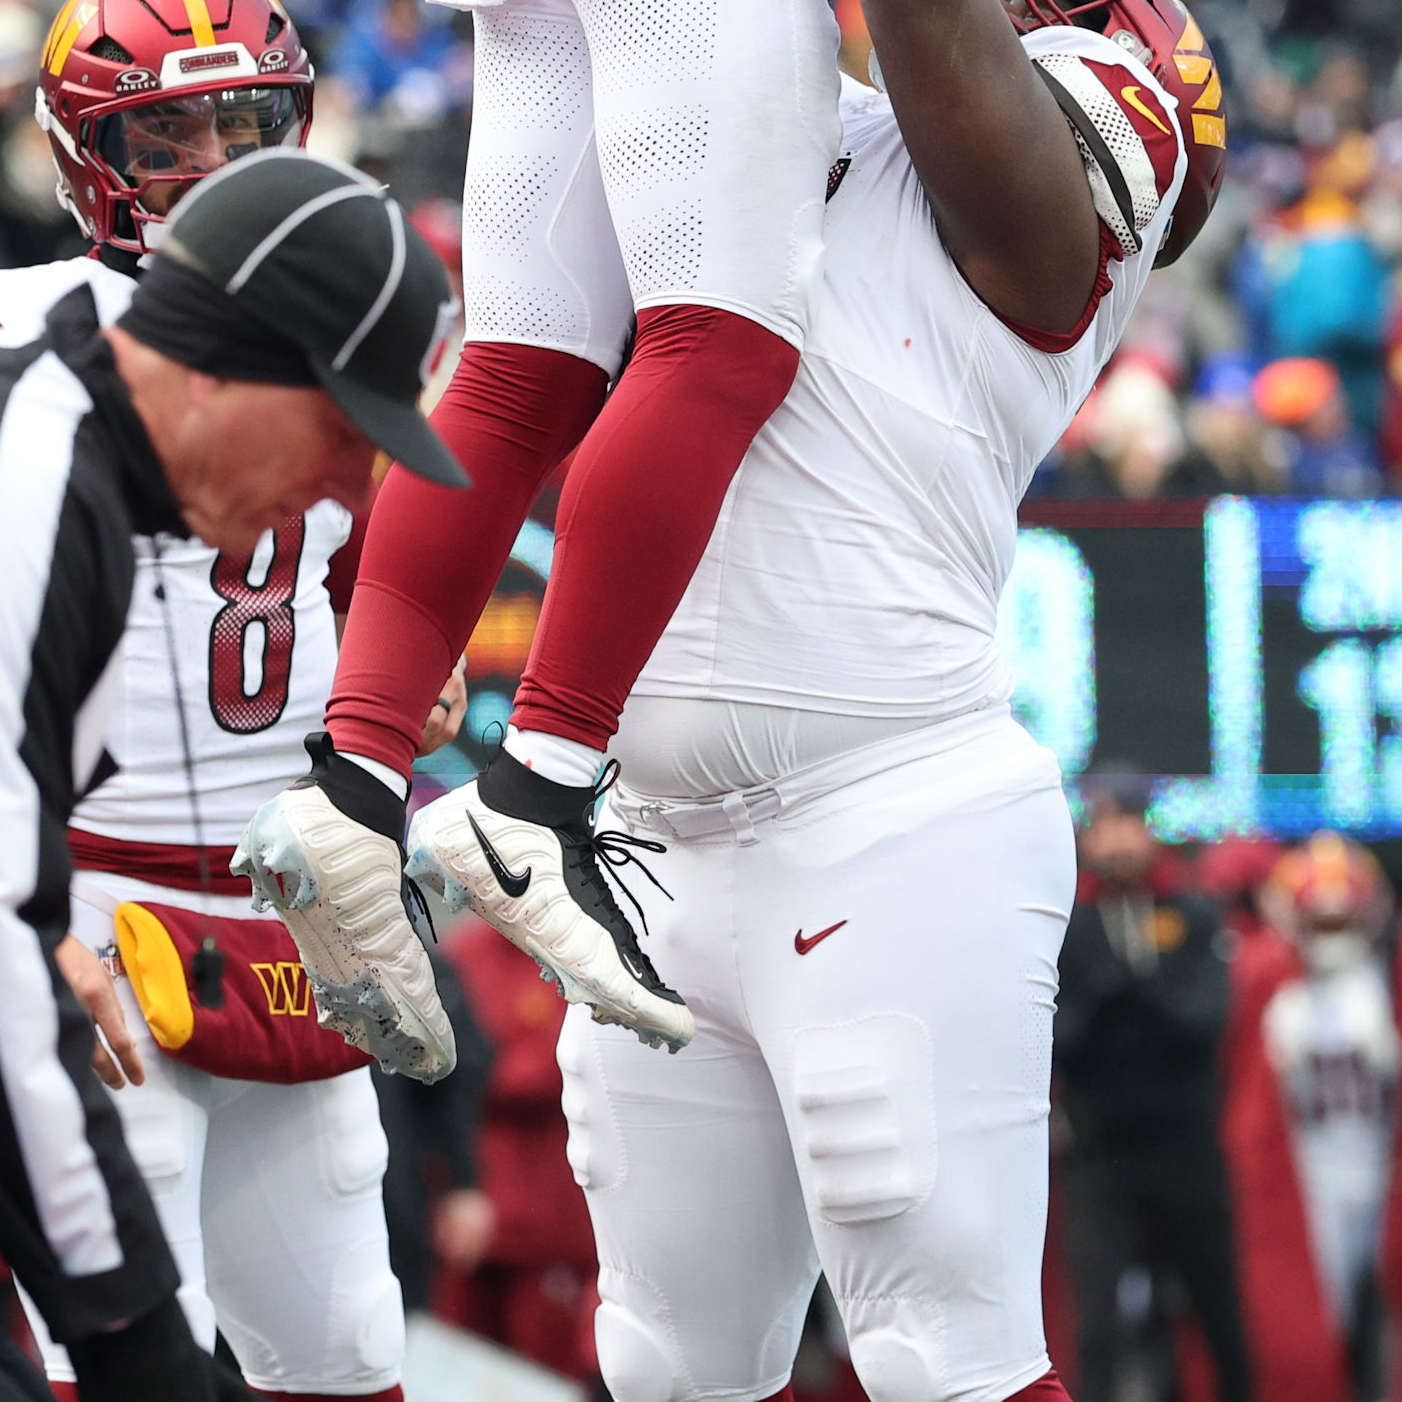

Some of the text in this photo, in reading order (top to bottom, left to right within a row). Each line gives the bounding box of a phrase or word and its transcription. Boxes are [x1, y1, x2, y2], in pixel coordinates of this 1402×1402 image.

[260, 60, 290, 74] OAKLEY
[115, 80, 158, 93] OAKLEY
[208, 511, 306, 735] 8
